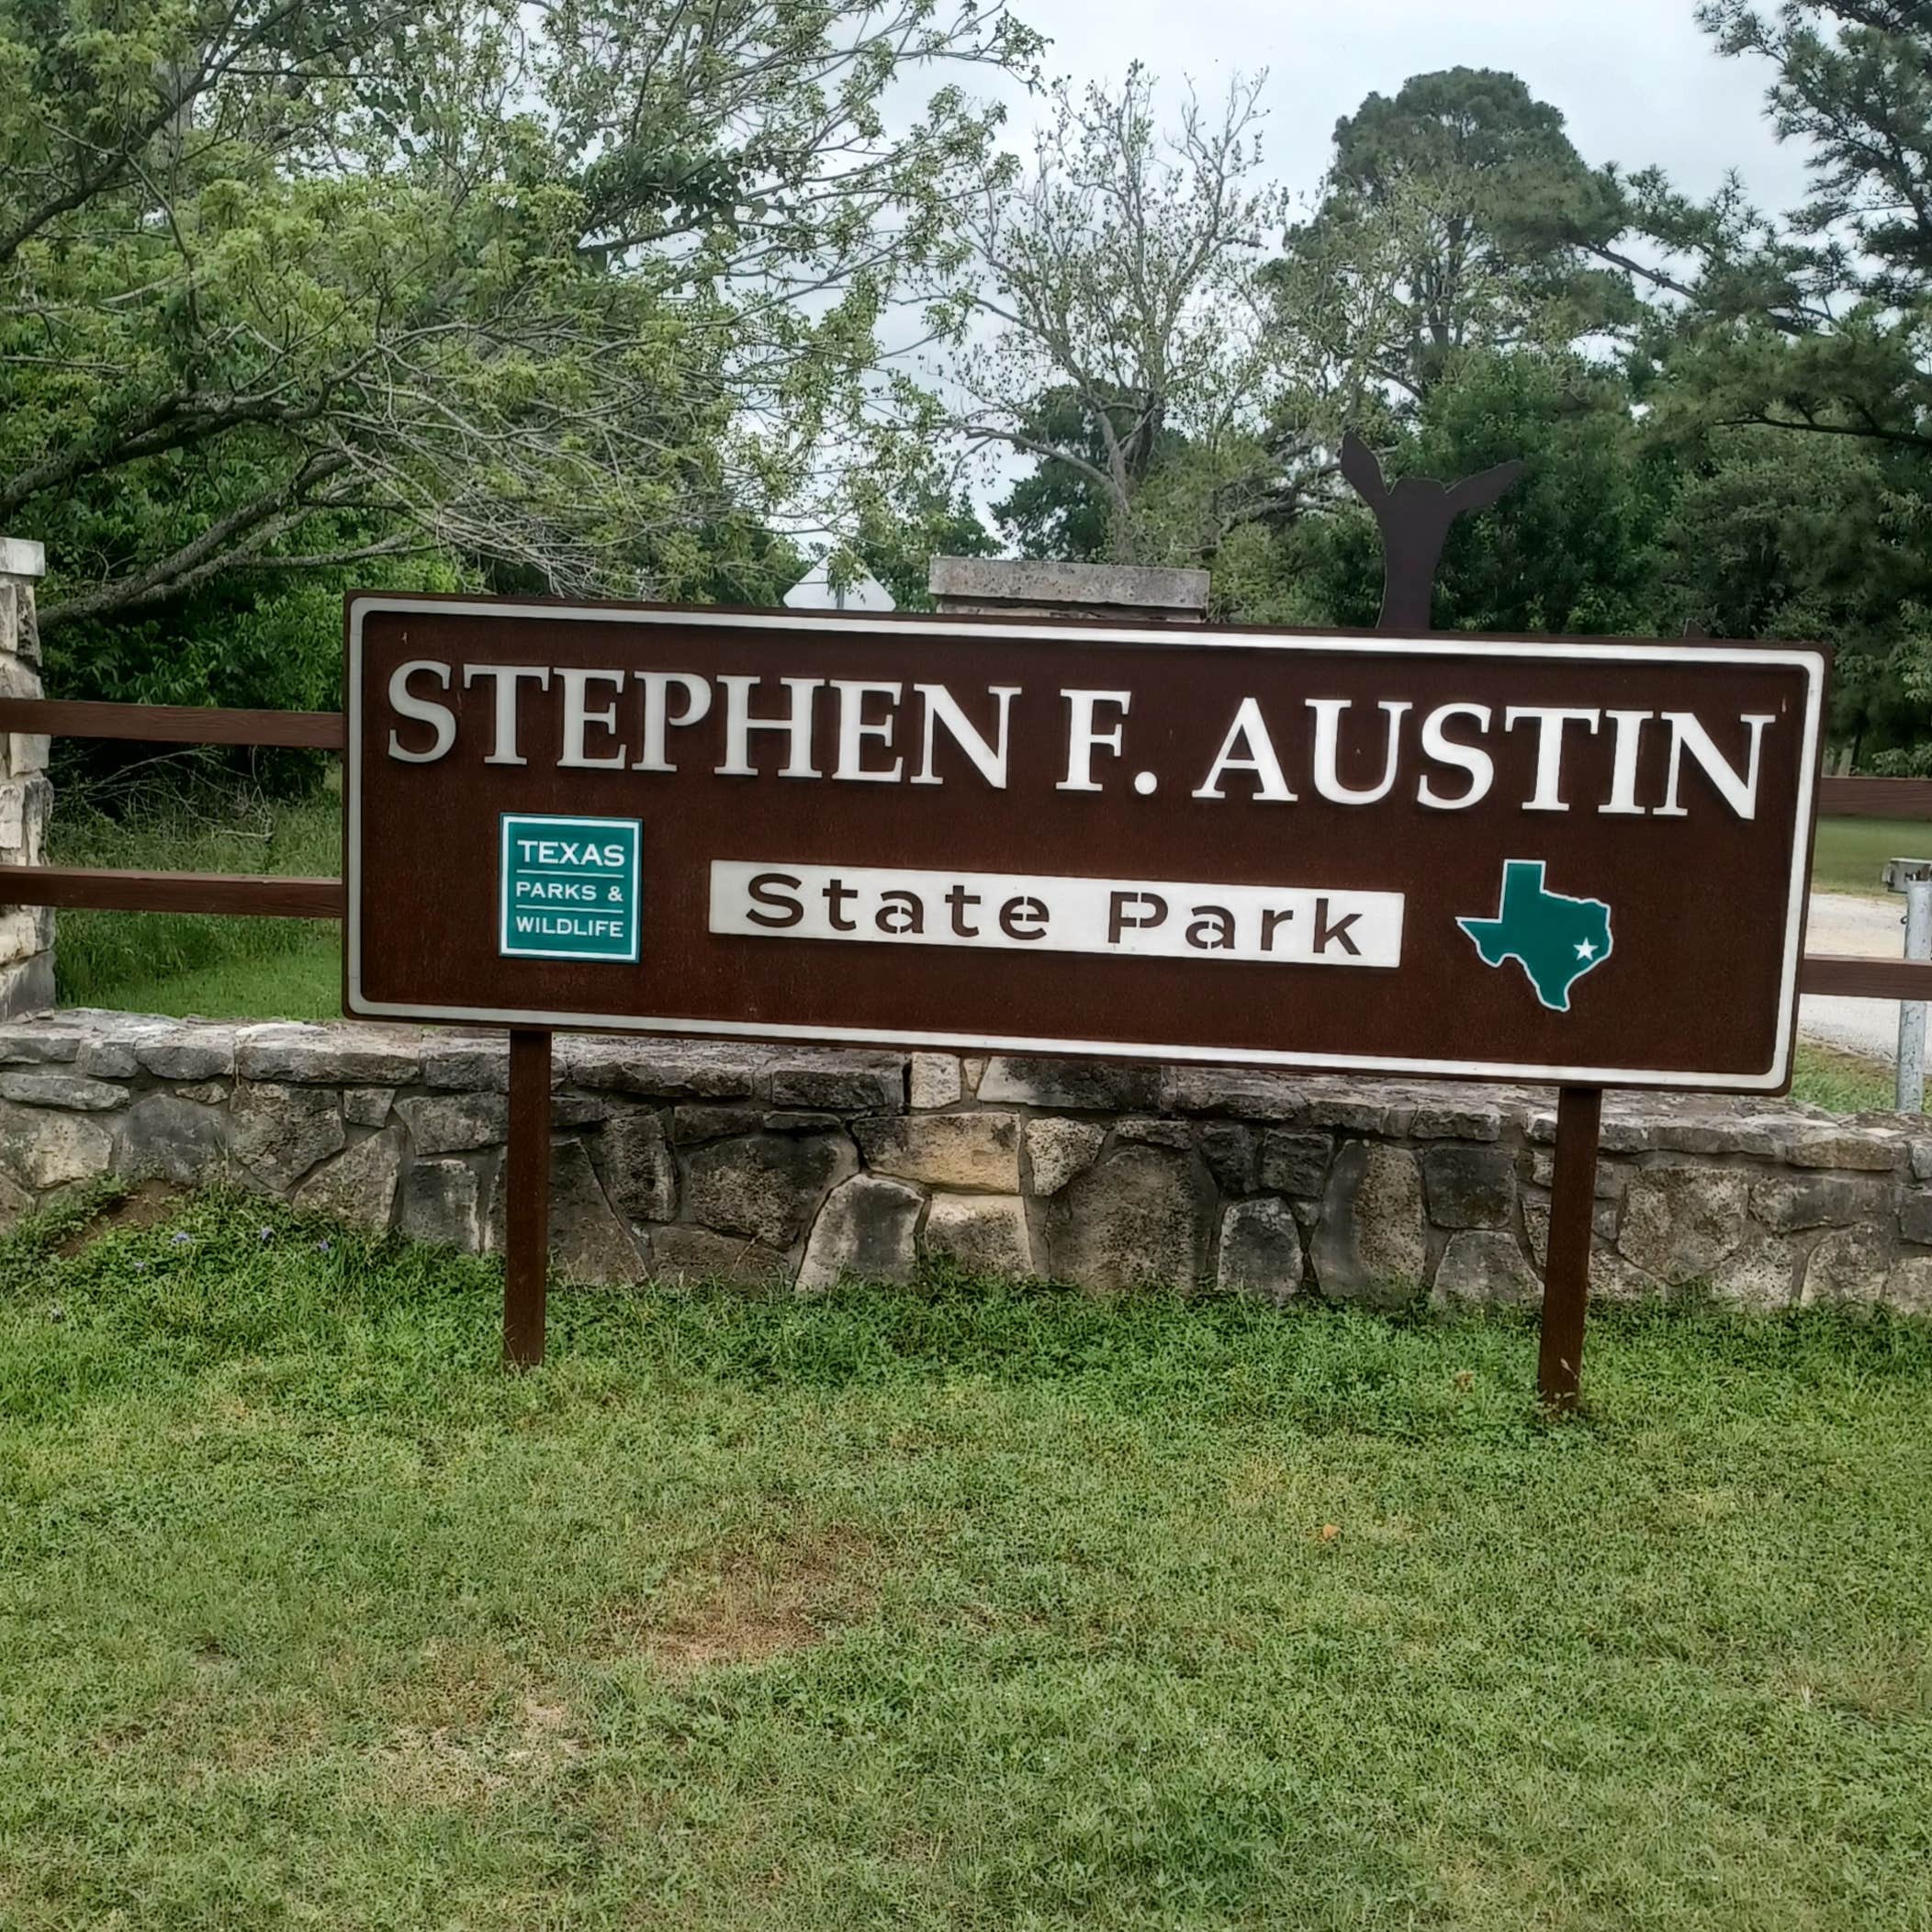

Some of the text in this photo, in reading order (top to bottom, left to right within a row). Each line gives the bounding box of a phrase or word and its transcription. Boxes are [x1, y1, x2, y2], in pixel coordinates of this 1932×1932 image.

[388, 660, 1776, 820] STEPHEN F. AUSTIN
[517, 839, 625, 867] TEXAS
[516, 882, 623, 902] PARKS &
[516, 916, 624, 938] WILDLIFE
[745, 872, 1363, 956] State Park
